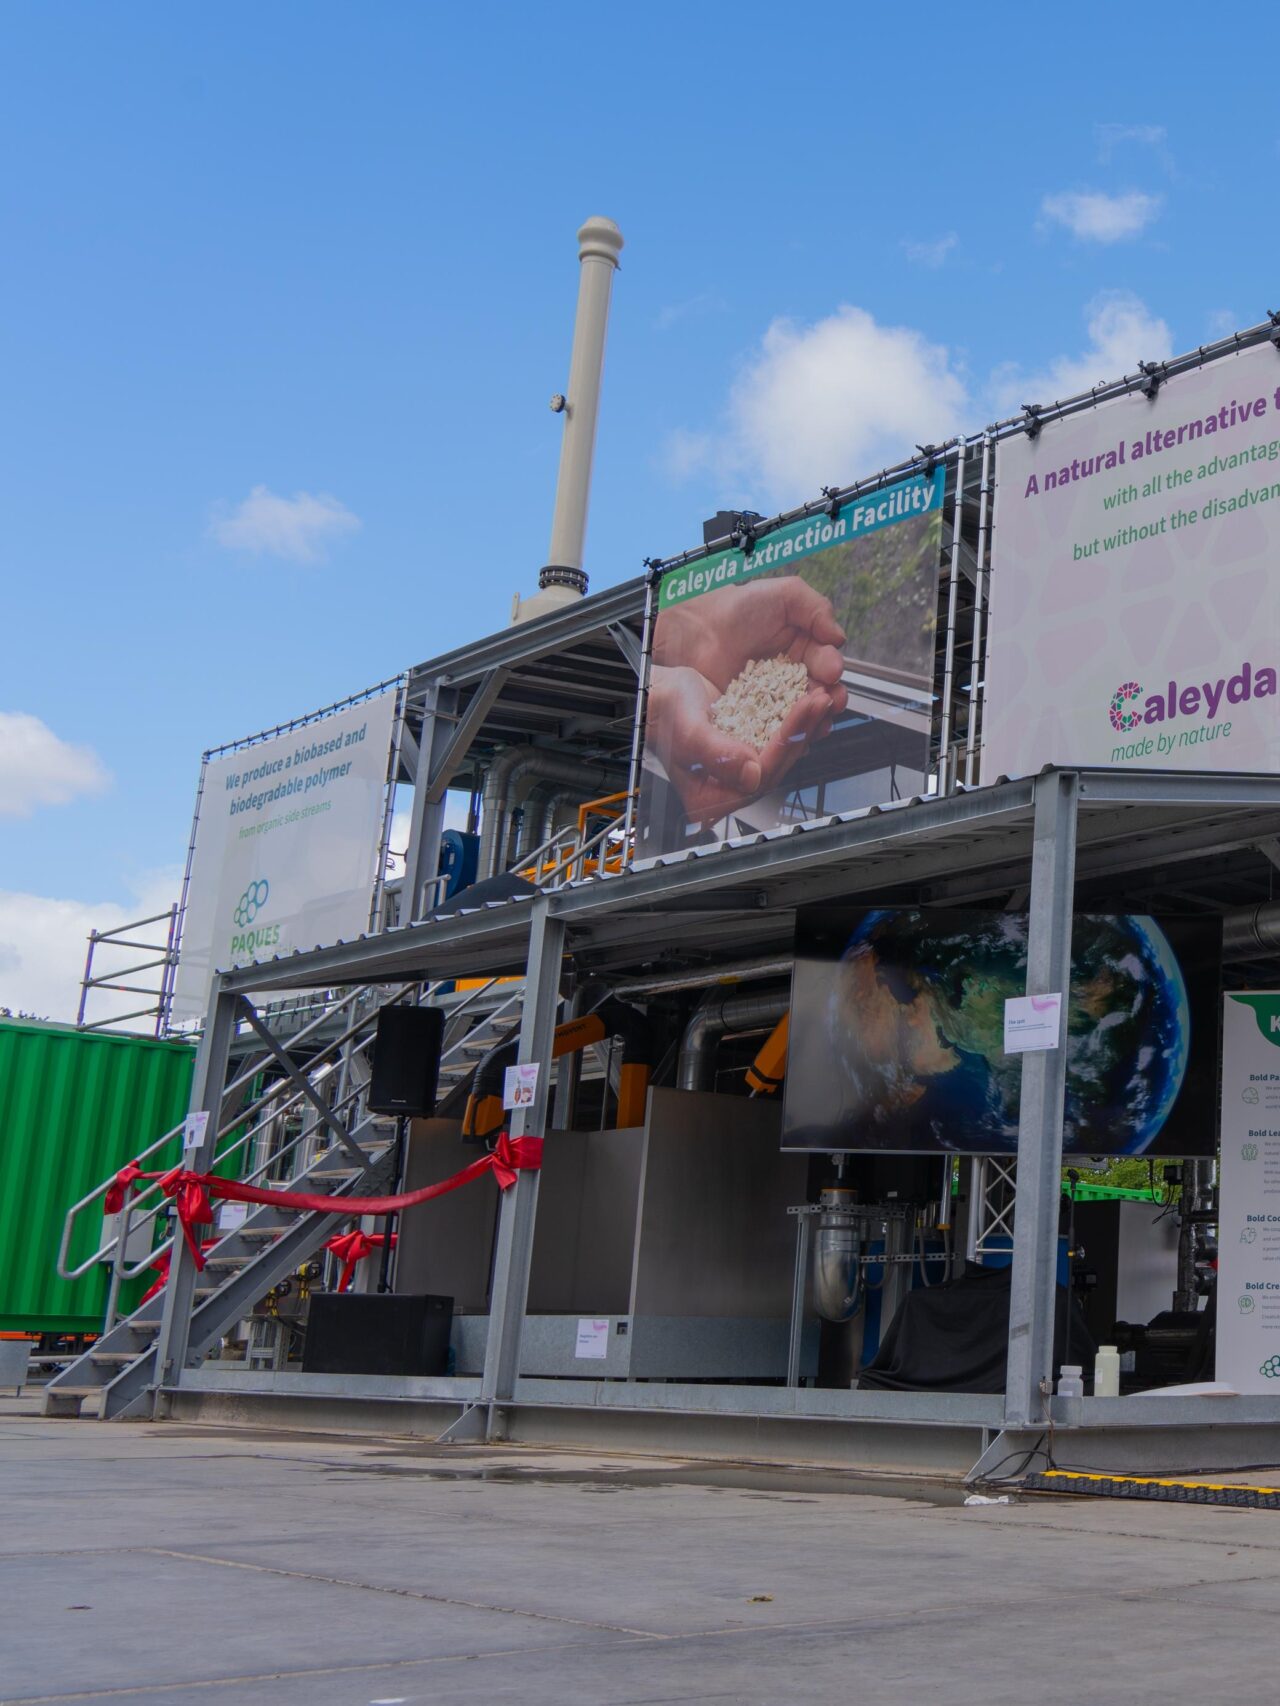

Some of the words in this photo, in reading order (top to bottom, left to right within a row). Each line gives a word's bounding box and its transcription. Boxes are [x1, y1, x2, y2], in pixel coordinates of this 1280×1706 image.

[1024, 475, 1040, 498] A
[1044, 440, 1125, 492] natural
[1131, 397, 1267, 459] alternative
[1103, 485, 1138, 511] with
[1142, 476, 1162, 498] all
[1166, 468, 1193, 491] the
[665, 558, 737, 601] Caleyda
[743, 518, 846, 573] Extraction
[852, 483, 936, 531] Facility
[1073, 538, 1100, 561] but
[1103, 516, 1166, 551] without
[1170, 507, 1198, 530] the
[1109, 662, 1277, 733] Caleyda
[225, 774, 240, 790] We
[242, 758, 283, 790] produce
[285, 756, 292, 769] a
[293, 733, 343, 766] biobased
[345, 723, 367, 746] and
[1110, 737, 1153, 763] made
[1156, 731, 1175, 757] by
[1178, 721, 1232, 748] nature
[230, 776, 303, 816] biodegradable
[304, 761, 352, 793] polymer
[239, 824, 256, 840] from
[257, 813, 283, 835] organic
[284, 807, 300, 824] side
[300, 800, 332, 821] streams
[231, 924, 281, 955] PAQUES
[1249, 1073, 1268, 1081] Bold
[1248, 1129, 1267, 1137] Bold
[1247, 1214, 1265, 1222] Bold
[1245, 1282, 1264, 1290] Bold
